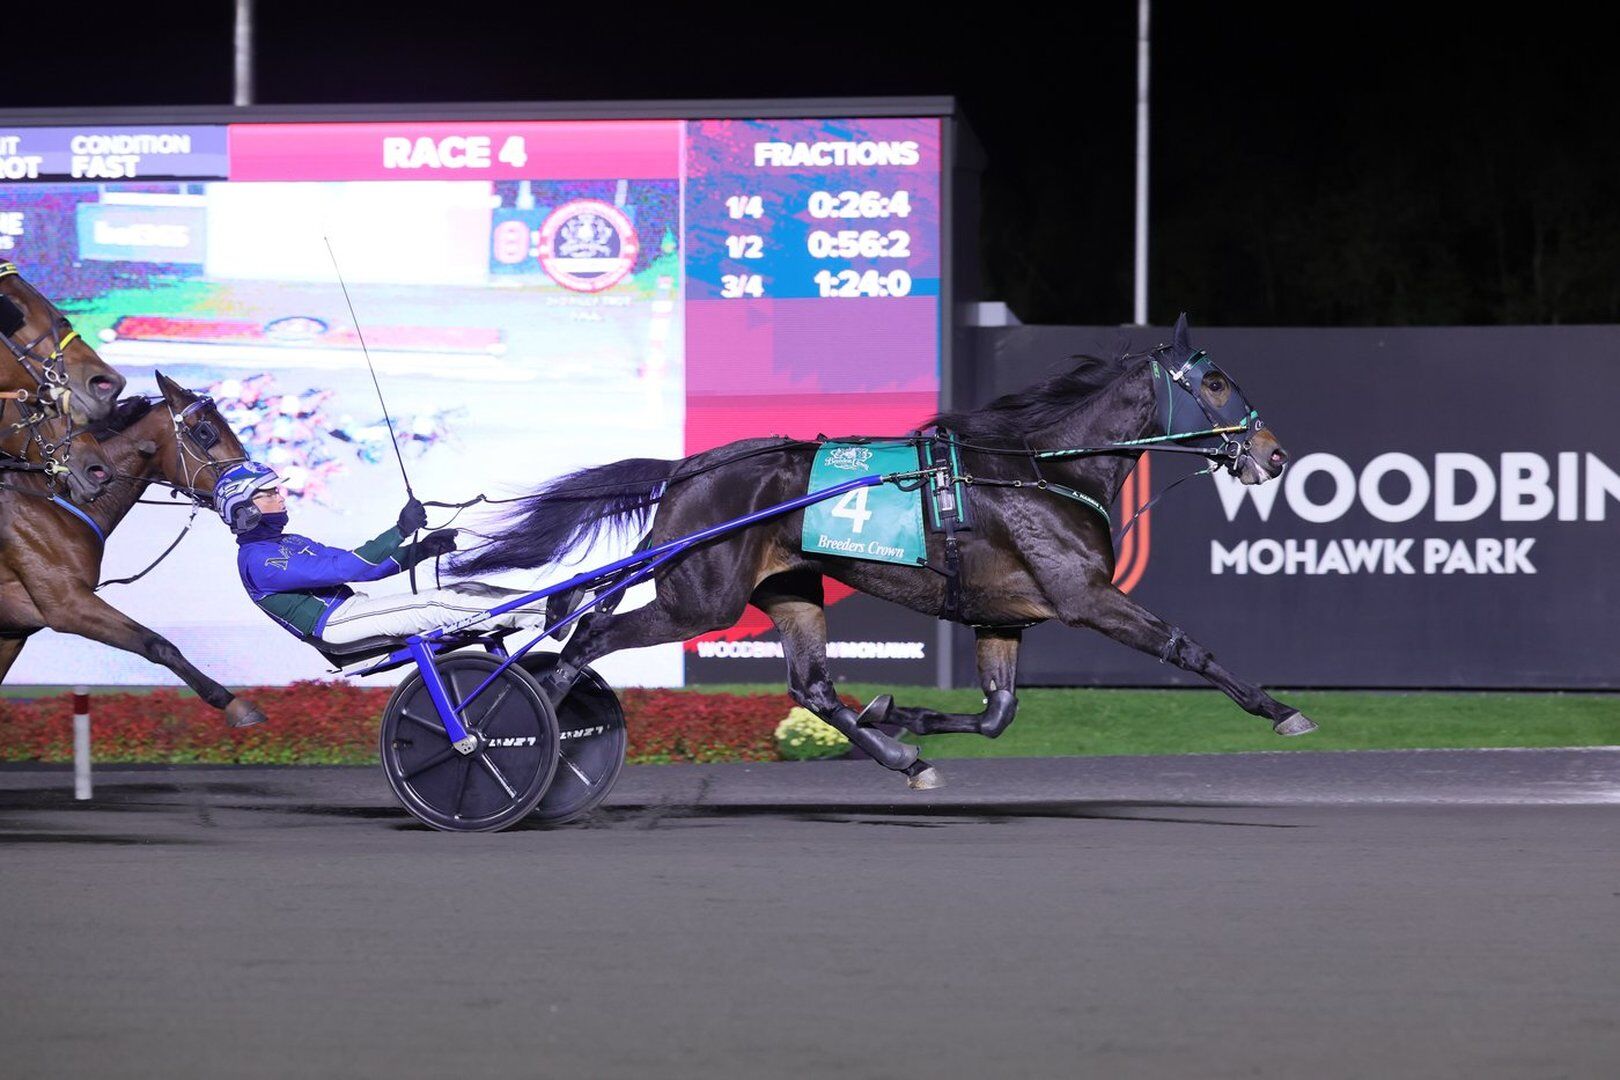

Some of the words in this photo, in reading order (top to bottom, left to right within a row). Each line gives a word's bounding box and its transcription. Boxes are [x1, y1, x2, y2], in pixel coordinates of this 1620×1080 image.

[71, 135, 191, 154] CONDITION
[383, 136, 491, 168] RACE
[498, 136, 527, 168] 4
[754, 141, 919, 166] FRACTIONS
[71, 155, 140, 178] FAST
[725, 196, 764, 219] 1/4
[808, 190, 911, 218] 0:26:4
[725, 235, 764, 258] 1/2
[807, 230, 910, 258] 0:56:2
[720, 274, 764, 298] 3/4
[814, 270, 911, 297] 1:24:0
[831, 486, 872, 534] 4
[818, 534, 864, 552] Breeders
[868, 540, 905, 558] Crown
[1211, 539, 1416, 575] MOHAWK
[1423, 538, 1537, 575] PARK
